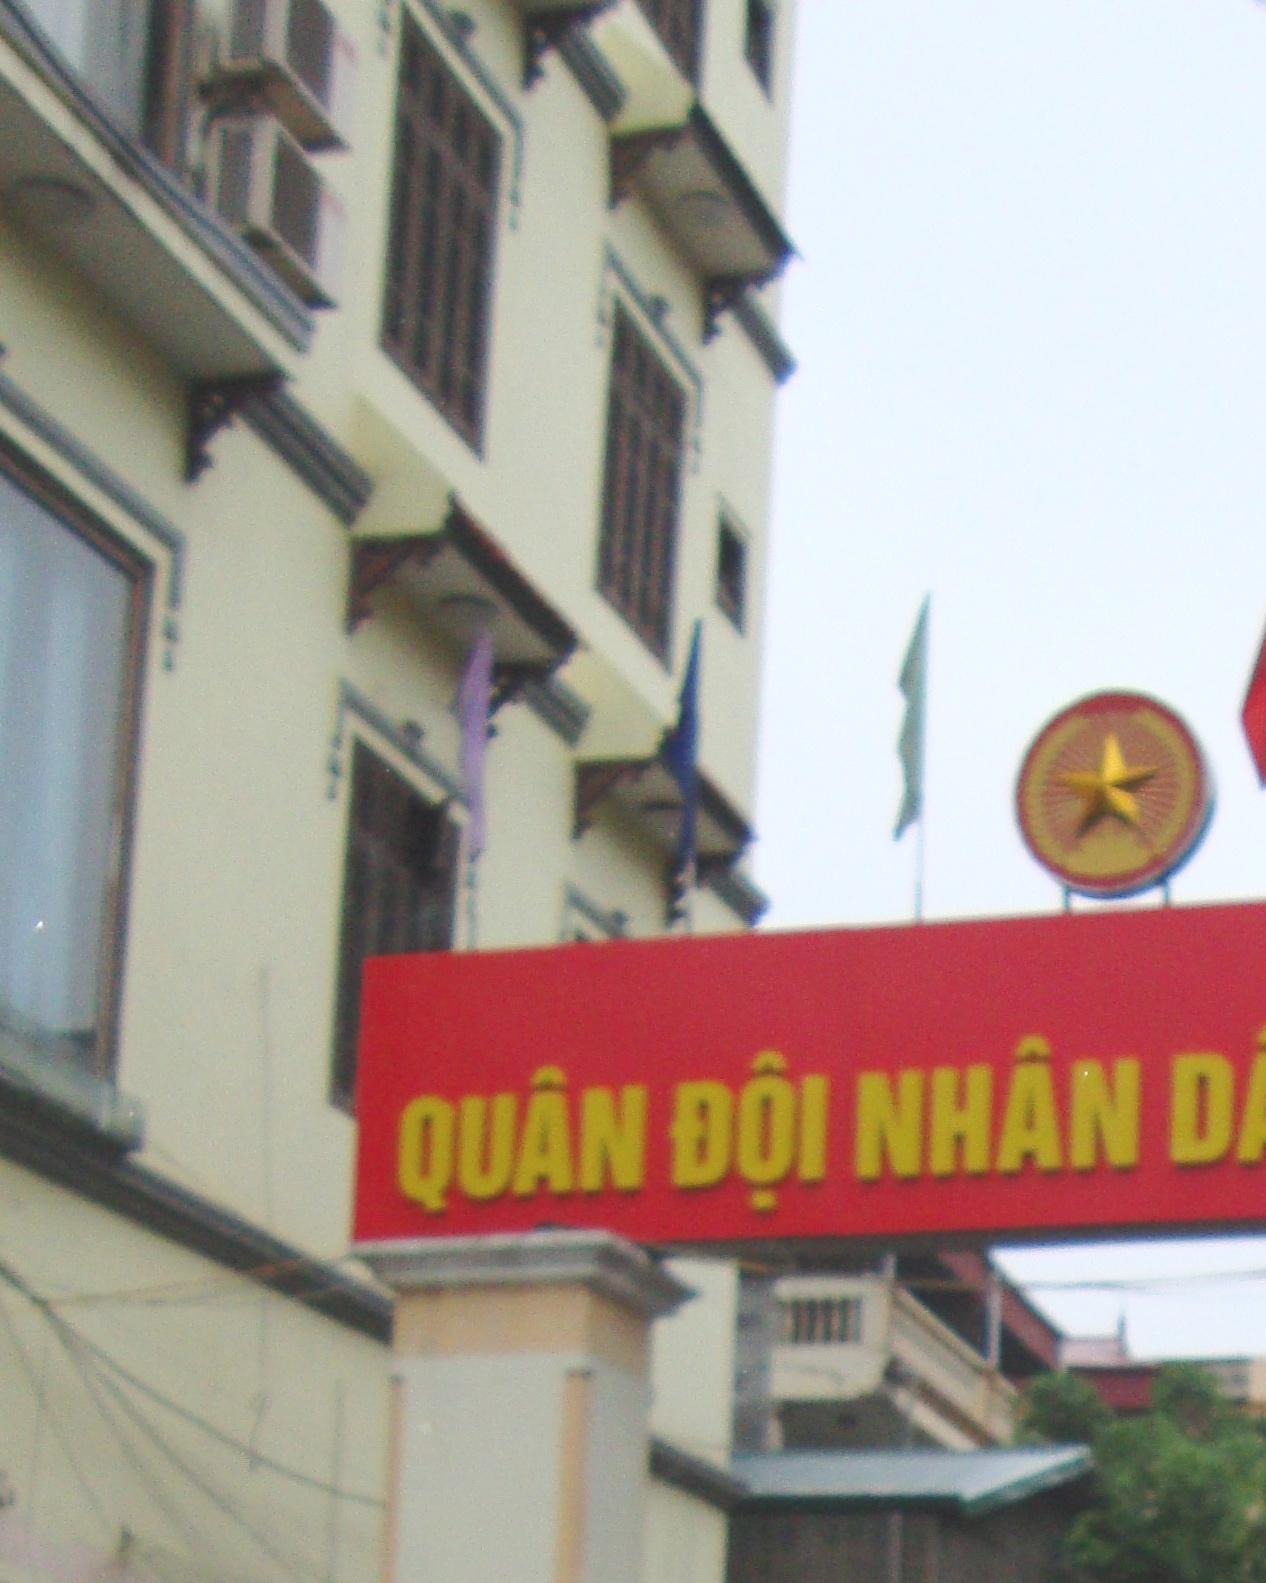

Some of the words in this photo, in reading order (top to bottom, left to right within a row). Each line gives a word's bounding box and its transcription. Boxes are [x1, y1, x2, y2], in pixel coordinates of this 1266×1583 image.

[399, 1066, 646, 1212] QUÂN
[670, 1050, 828, 1212] ĐỘI
[855, 1034, 1140, 1181] NHÂN
